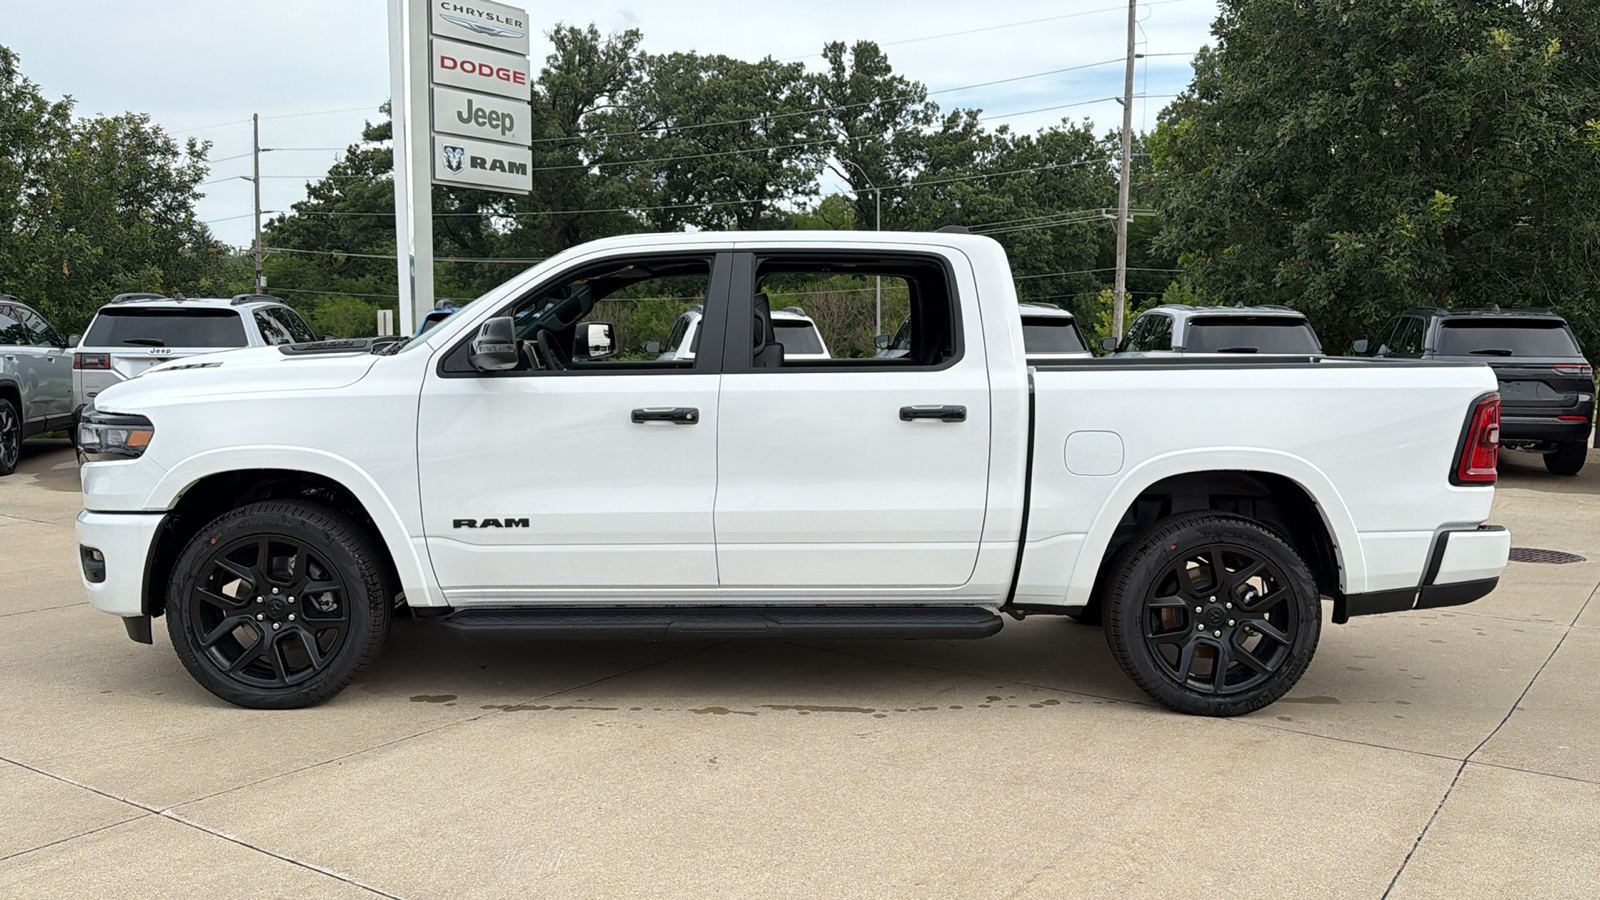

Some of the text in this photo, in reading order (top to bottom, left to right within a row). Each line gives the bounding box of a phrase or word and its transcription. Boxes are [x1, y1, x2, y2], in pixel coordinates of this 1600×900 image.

[440, 2, 523, 29] CHRYSLER
[440, 55, 526, 85] DODGE
[457, 98, 515, 136] Jeep
[470, 155, 527, 176] RAM
[453, 518, 530, 529] RAM
